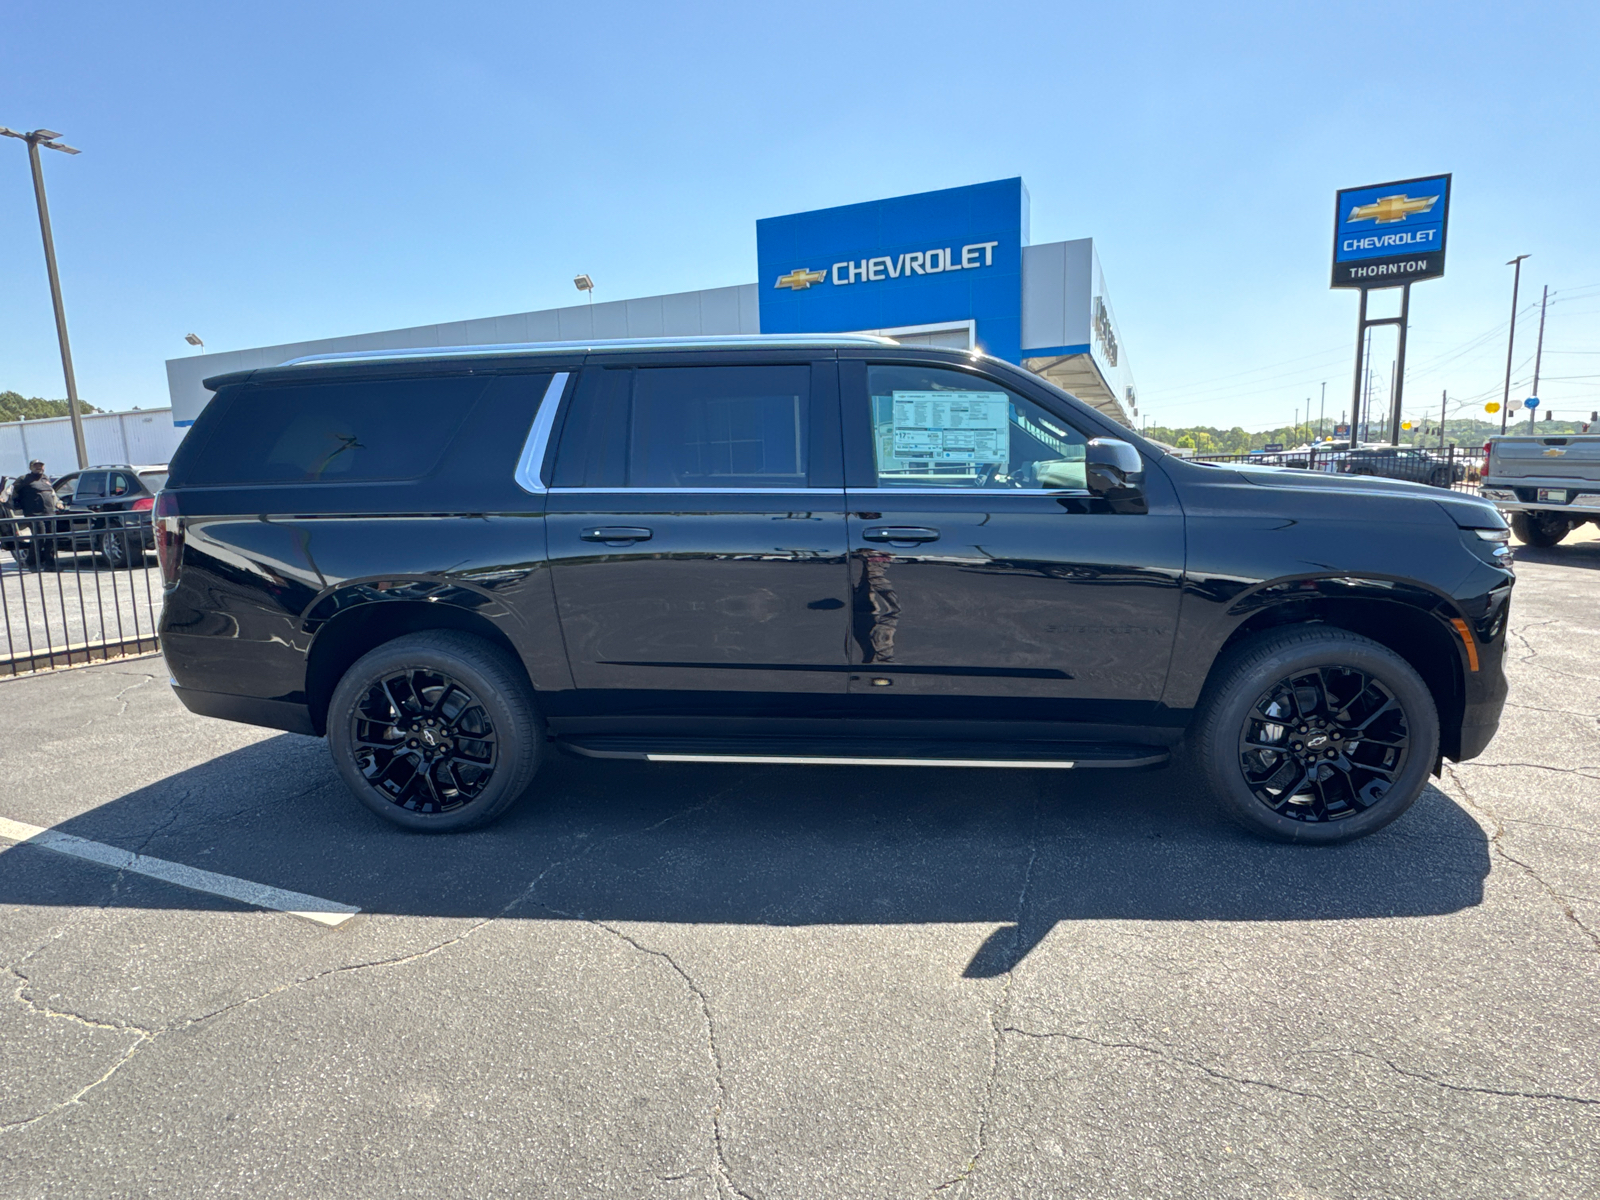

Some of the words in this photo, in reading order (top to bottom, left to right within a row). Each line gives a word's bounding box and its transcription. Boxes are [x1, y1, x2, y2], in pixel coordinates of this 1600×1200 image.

[1343, 229, 1437, 251] CHEVROLET
[832, 241, 998, 286] CHEVROLET
[1349, 260, 1427, 278] THORNTON
